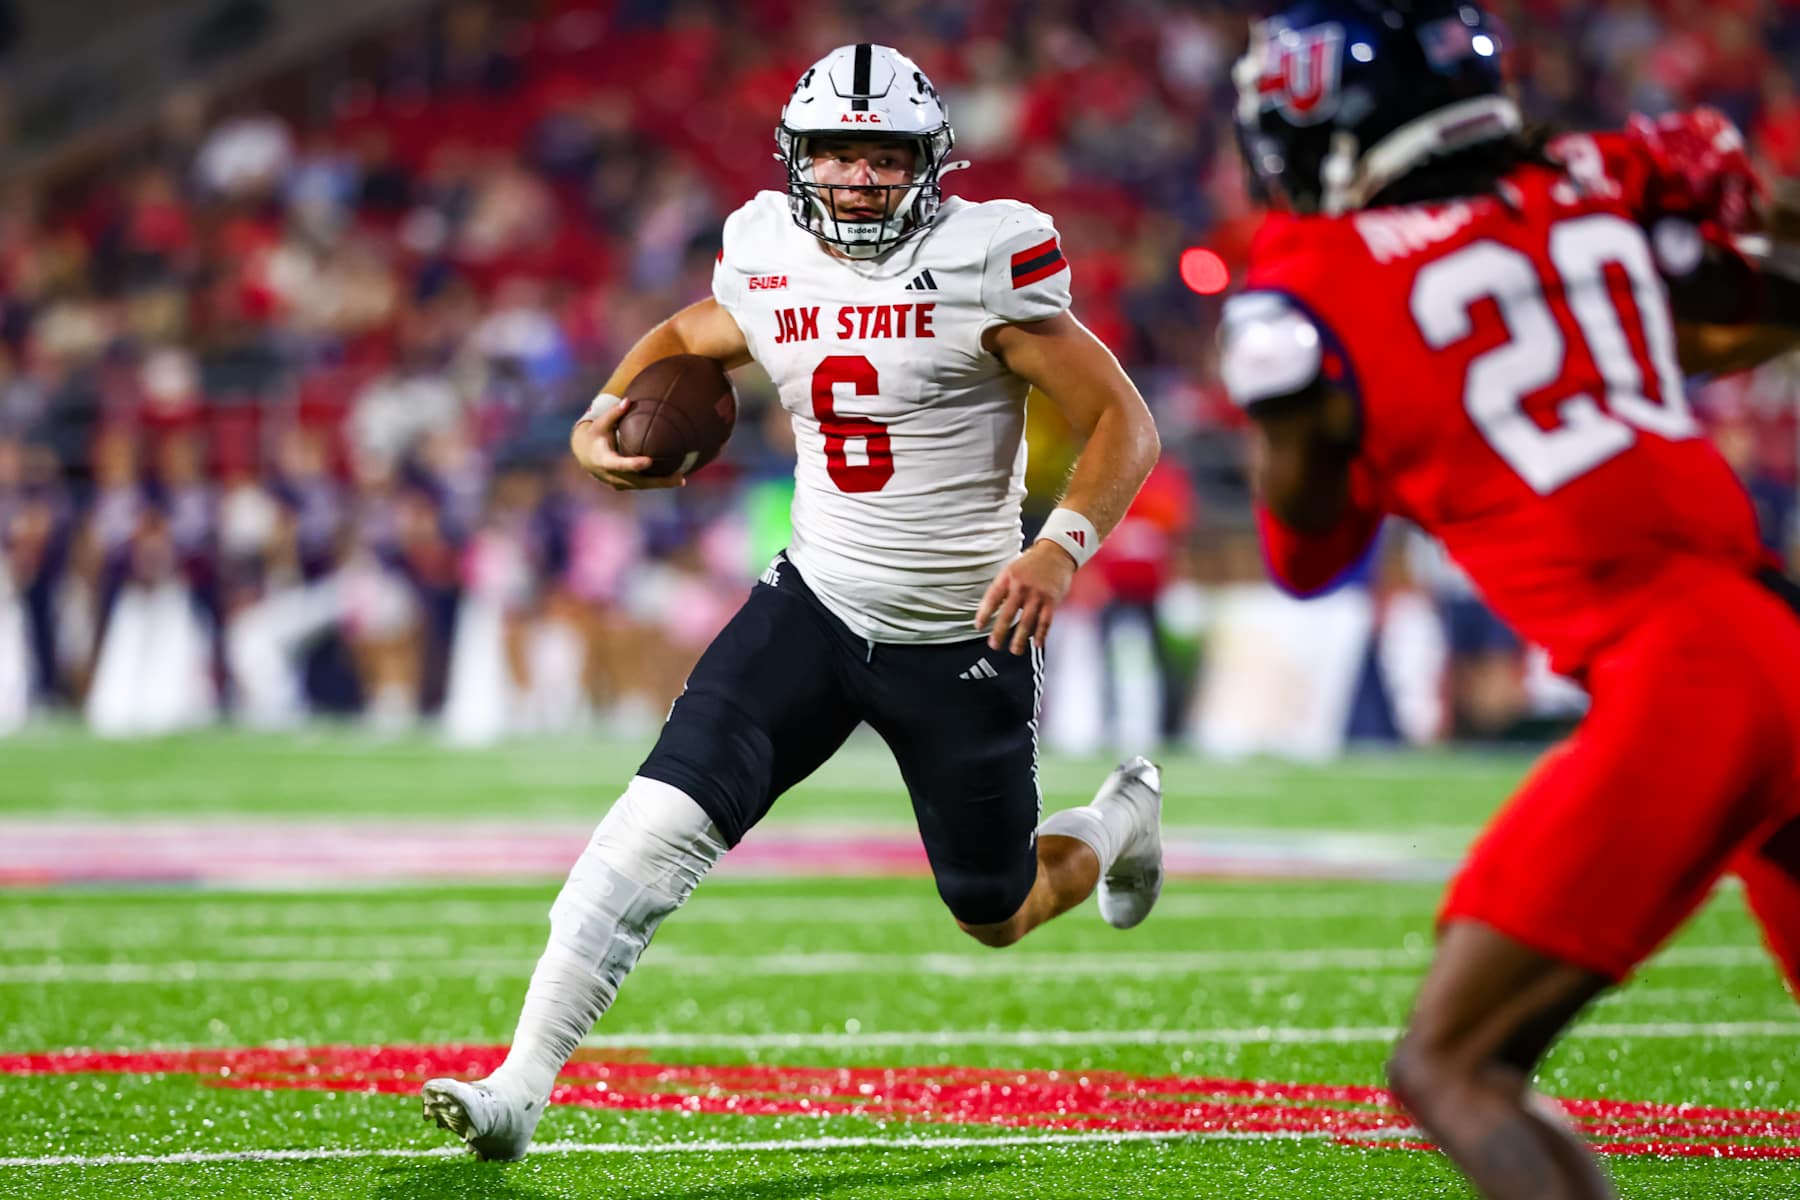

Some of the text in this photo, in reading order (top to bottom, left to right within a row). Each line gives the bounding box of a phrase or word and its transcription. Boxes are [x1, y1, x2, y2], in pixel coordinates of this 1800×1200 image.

[847, 226, 878, 234] Riddell
[774, 302, 936, 344] JAX STATE
[1408, 211, 1699, 495] 20
[811, 355, 895, 493] 6
